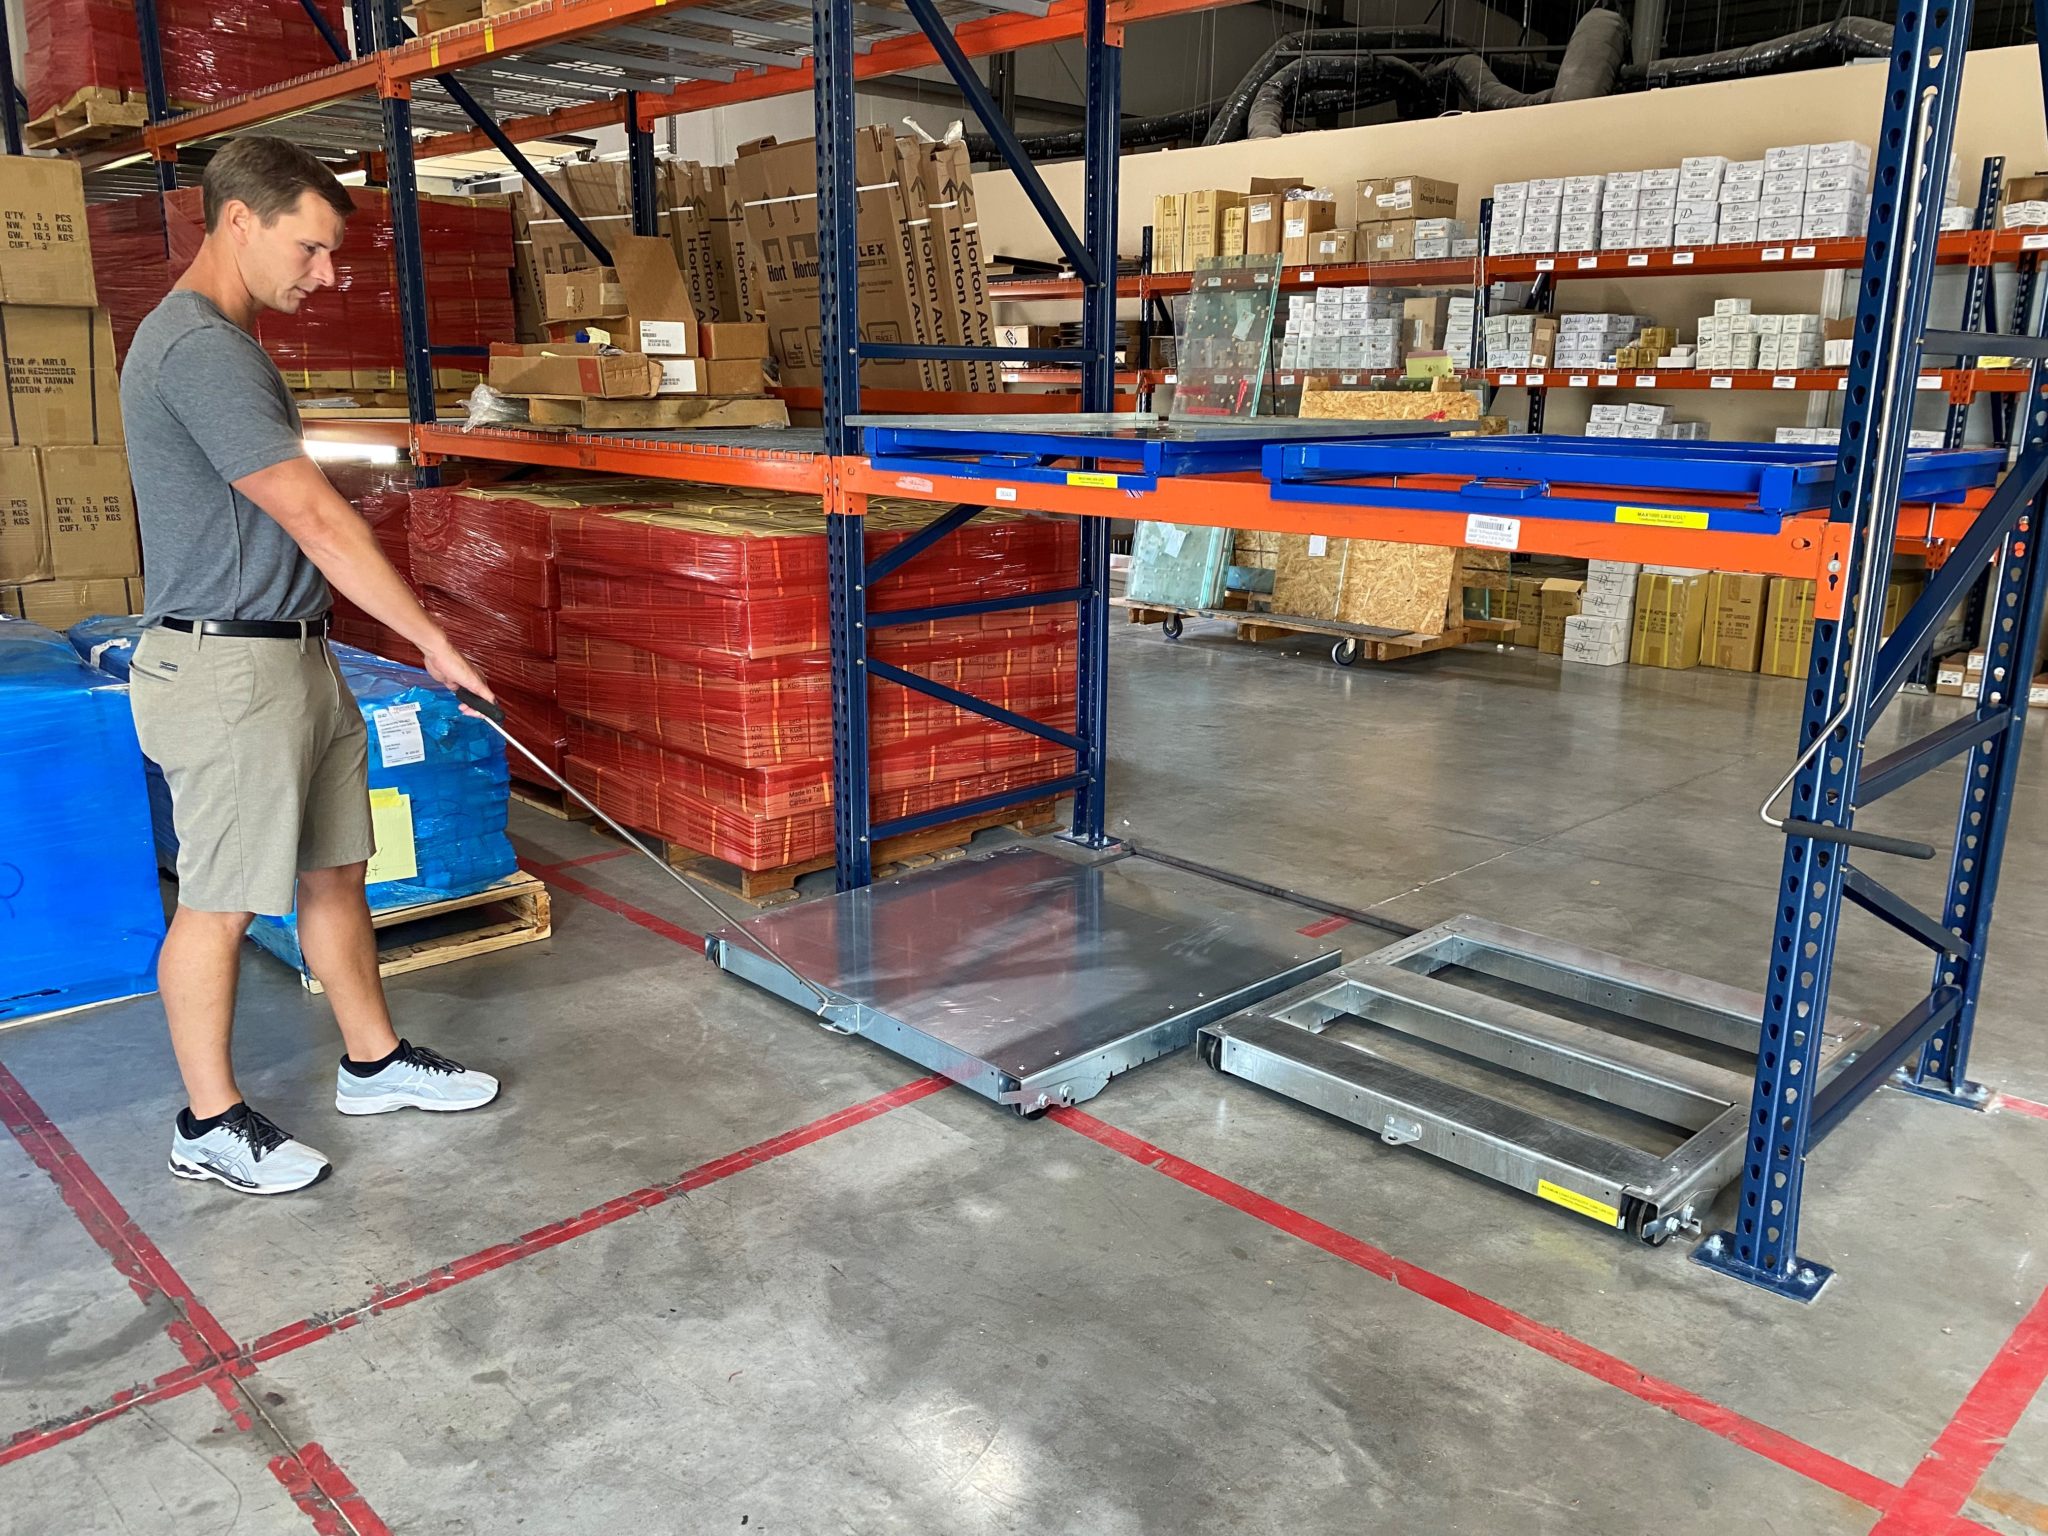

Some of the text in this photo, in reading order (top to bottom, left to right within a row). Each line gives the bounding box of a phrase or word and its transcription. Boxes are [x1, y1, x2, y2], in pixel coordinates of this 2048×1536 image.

[33, 223, 49, 231] 13.5
[57, 224, 73, 232] KGS
[34, 232, 51, 241] 16.5
[58, 234, 74, 242] KGS
[37, 213, 42, 221] 5
[55, 214, 71, 222] PCS
[687, 238, 701, 302] Horton
[700, 237, 715, 301] Horton
[736, 242, 749, 306] Horton
[767, 265, 787, 281] Hort
[899, 218, 916, 297] Horton
[920, 225, 938, 302] Horton
[950, 227, 966, 304] Horton
[966, 230, 983, 306] Horton
[789, 789, 805, 798] Made
